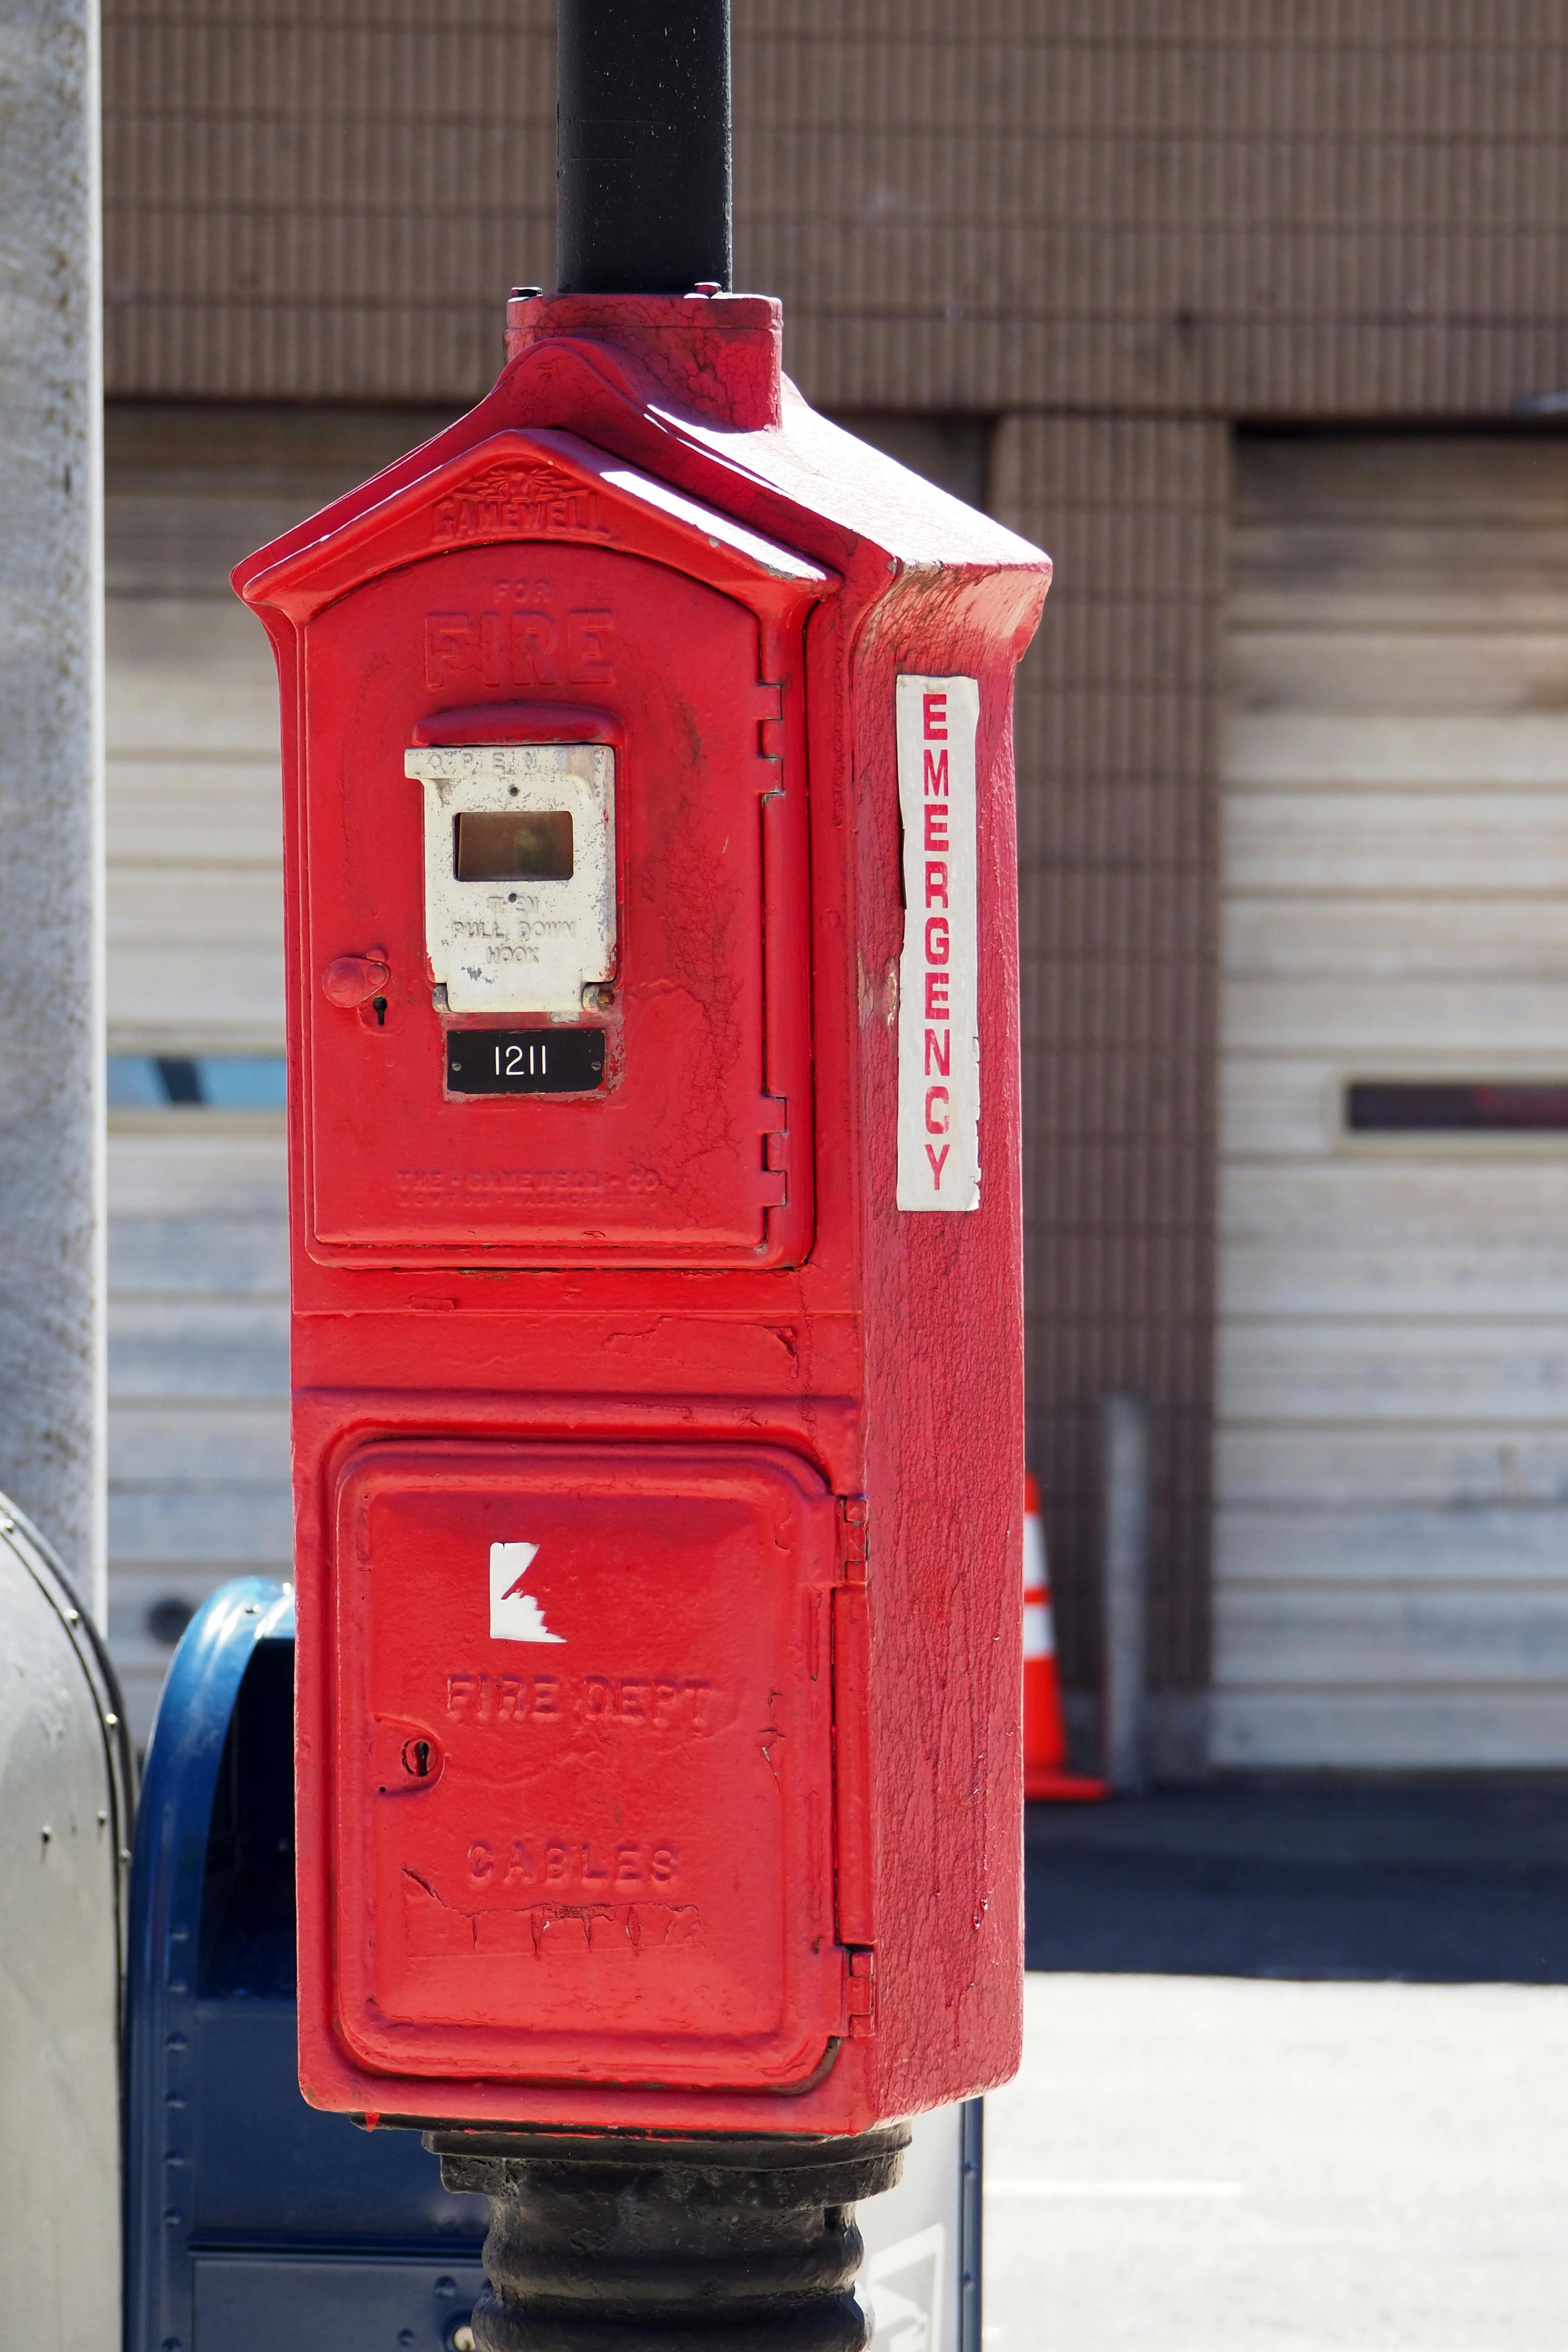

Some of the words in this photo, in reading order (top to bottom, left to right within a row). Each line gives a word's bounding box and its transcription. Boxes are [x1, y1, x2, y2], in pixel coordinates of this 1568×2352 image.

[431, 490, 610, 543] GAMEWELL
[493, 578, 550, 604] FOR
[424, 608, 614, 689] FIRE
[428, 751, 538, 771] OPEN
[451, 920, 506, 938] PULL
[518, 920, 575, 940] DOWN
[922, 693, 950, 1191] EMERGENCY
[485, 945, 539, 964] HOOK
[495, 1045, 546, 1076] 1211
[397, 1169, 443, 1192] THE
[468, 1169, 602, 1192] GAMEWELL
[446, 1675, 559, 1724] FIRE
[583, 1675, 712, 1727] DEPT
[468, 1840, 678, 1886] CABLES
